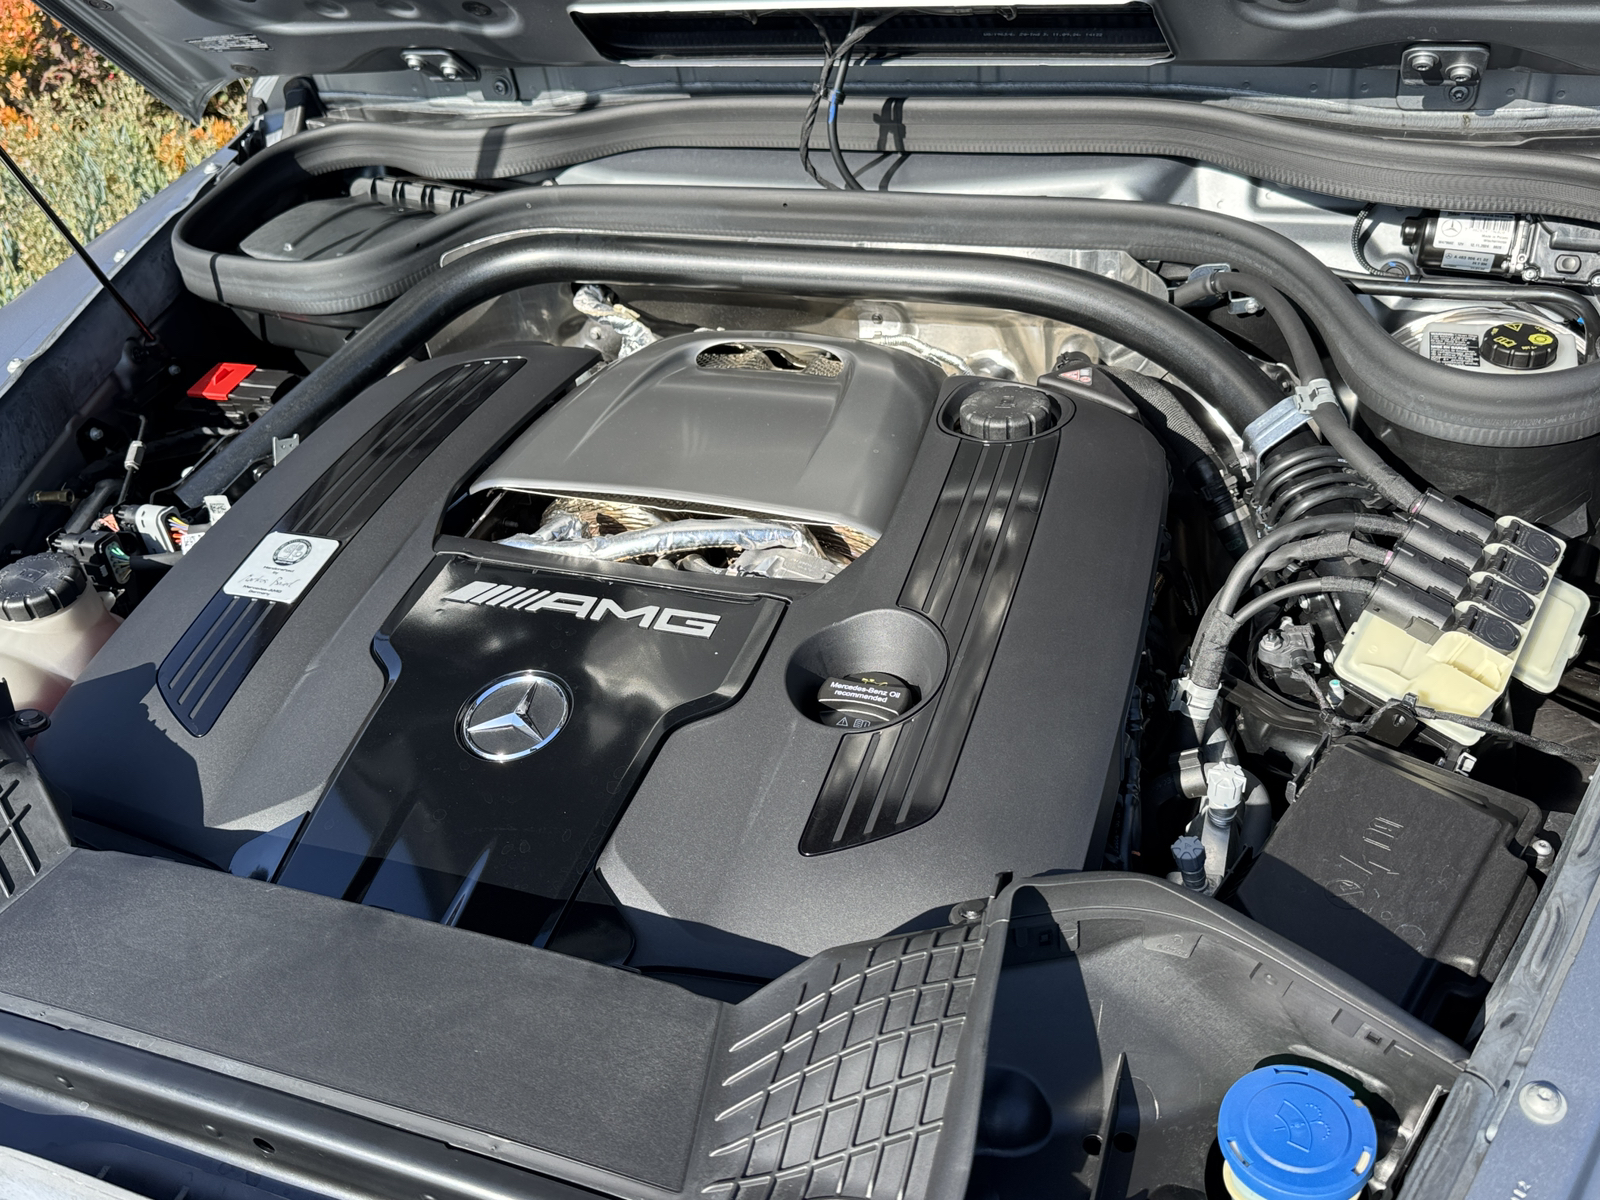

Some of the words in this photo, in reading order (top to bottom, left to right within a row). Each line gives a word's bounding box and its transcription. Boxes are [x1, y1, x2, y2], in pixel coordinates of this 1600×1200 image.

[525, 591, 721, 640] AMG
[830, 681, 888, 697] Mercedes-Benz
[889, 691, 901, 699] Oil
[834, 690, 888, 703] recommended
